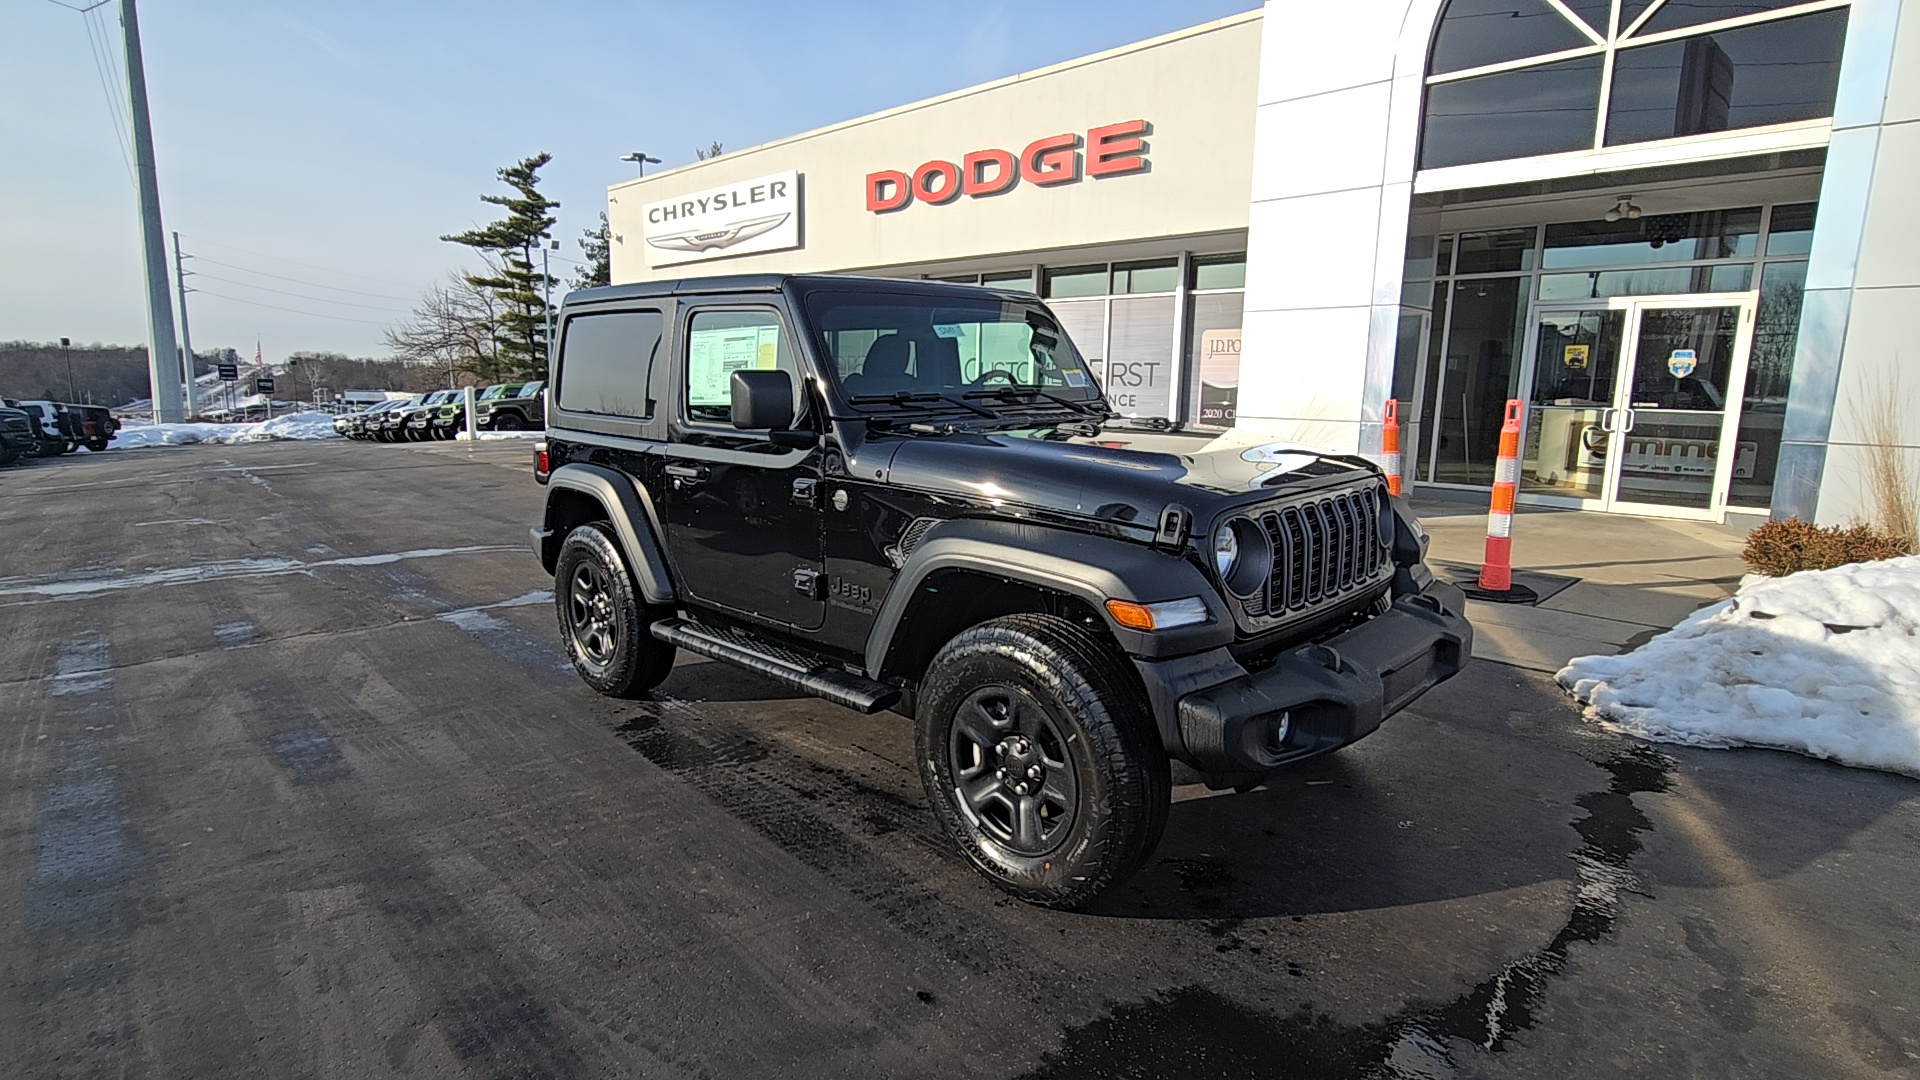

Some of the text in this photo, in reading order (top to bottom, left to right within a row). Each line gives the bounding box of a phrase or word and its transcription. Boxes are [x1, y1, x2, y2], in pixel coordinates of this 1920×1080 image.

[865, 119, 1152, 214] DODGE
[648, 180, 787, 224] CHRYSLER
[1201, 408, 1223, 419] 2020
[830, 576, 872, 604] Jeep
